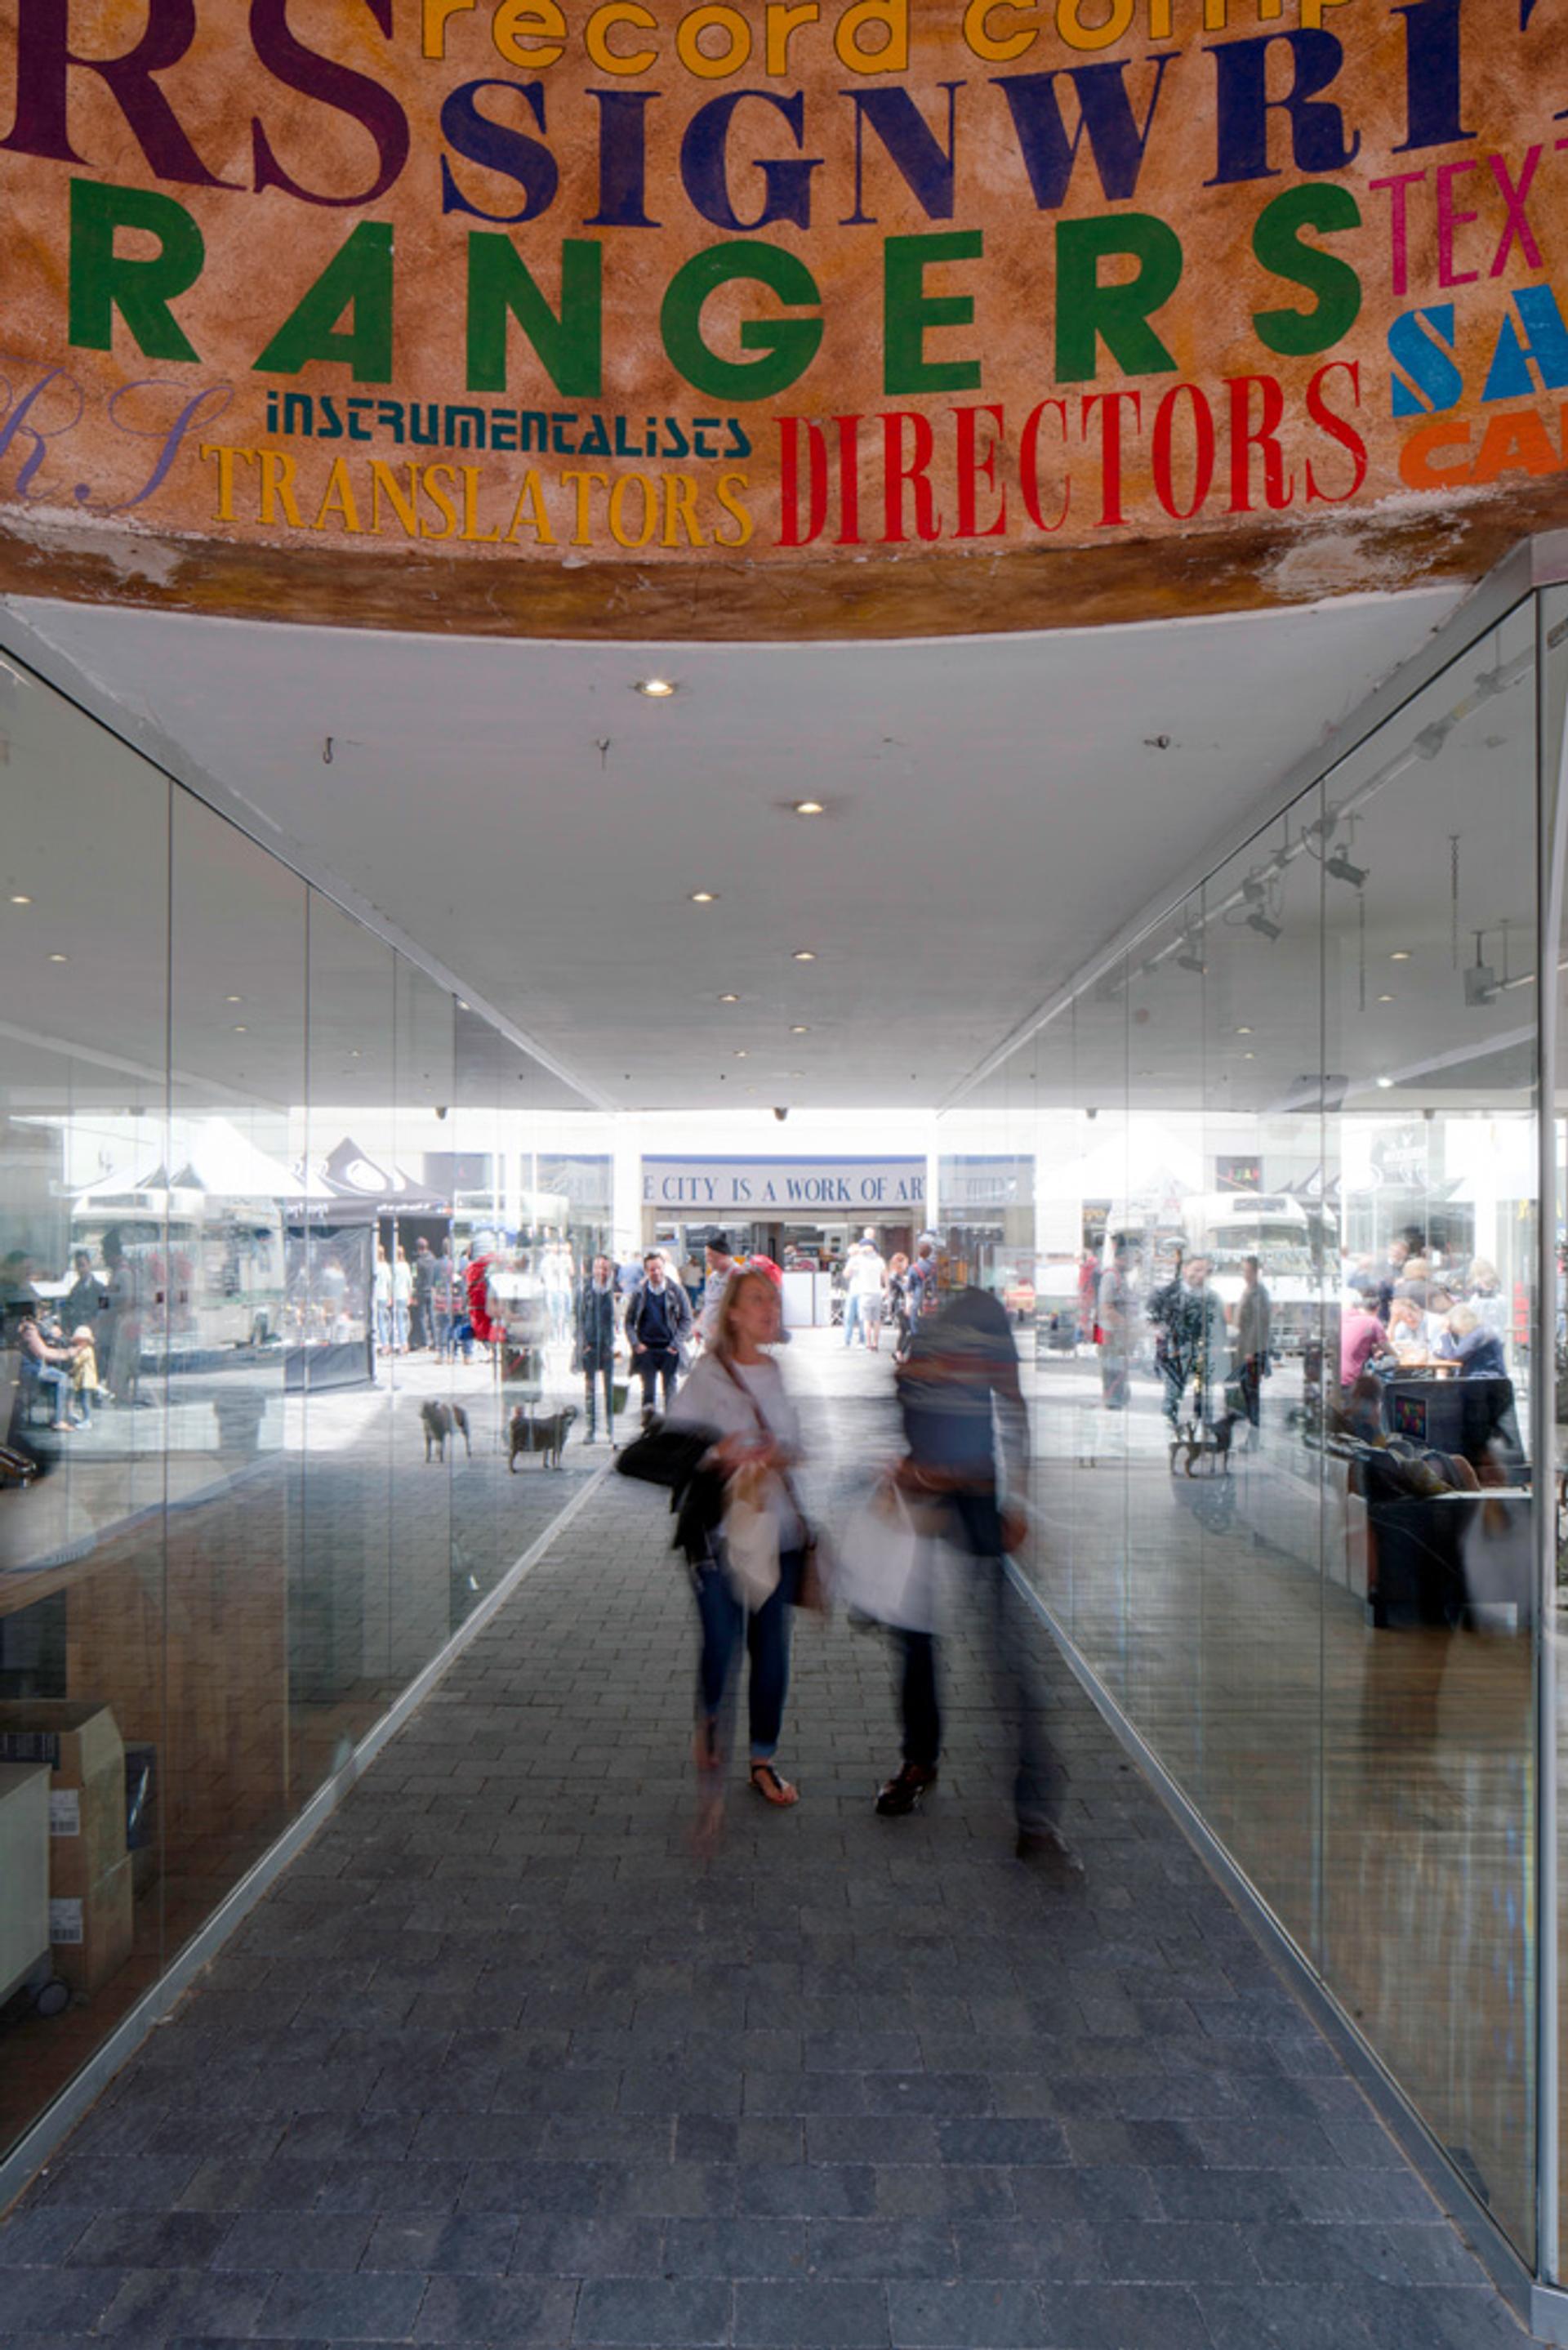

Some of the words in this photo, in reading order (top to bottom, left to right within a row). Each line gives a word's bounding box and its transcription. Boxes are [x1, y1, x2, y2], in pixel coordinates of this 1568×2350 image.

[422, 0, 909, 78] record
[440, 0, 1568, 233] SIGNWRI
[1369, 139, 1568, 296] TEX
[69, 176, 1362, 402] RANGERS
[199, 444, 754, 549] TRANSLATORS
[773, 360, 1368, 546] DIRECTORS
[1398, 404, 1568, 491] CA
[662, 1177, 719, 1201] CITY
[733, 1177, 752, 1202] IS
[761, 1179, 777, 1202] A
[786, 1177, 852, 1202] WORK
[861, 1177, 889, 1201] OF
[895, 1176, 925, 1201] AR
